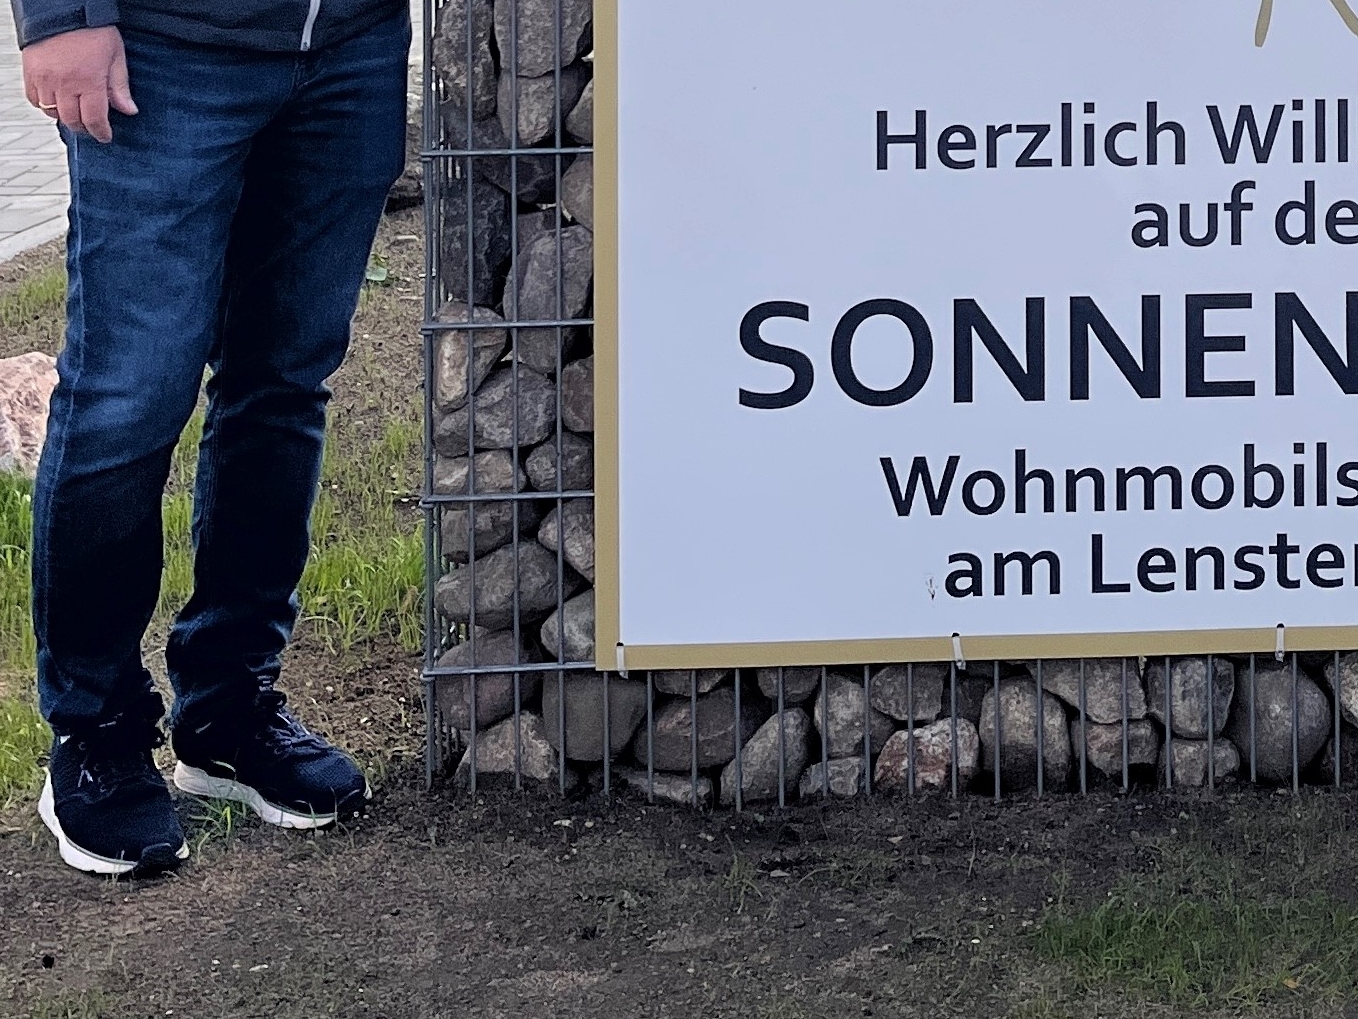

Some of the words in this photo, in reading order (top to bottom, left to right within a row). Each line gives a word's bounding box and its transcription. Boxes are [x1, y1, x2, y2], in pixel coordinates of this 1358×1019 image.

[876, 100, 1186, 171] Herzlich
[1131, 179, 1257, 249] auf
[944, 550, 1061, 599] am
